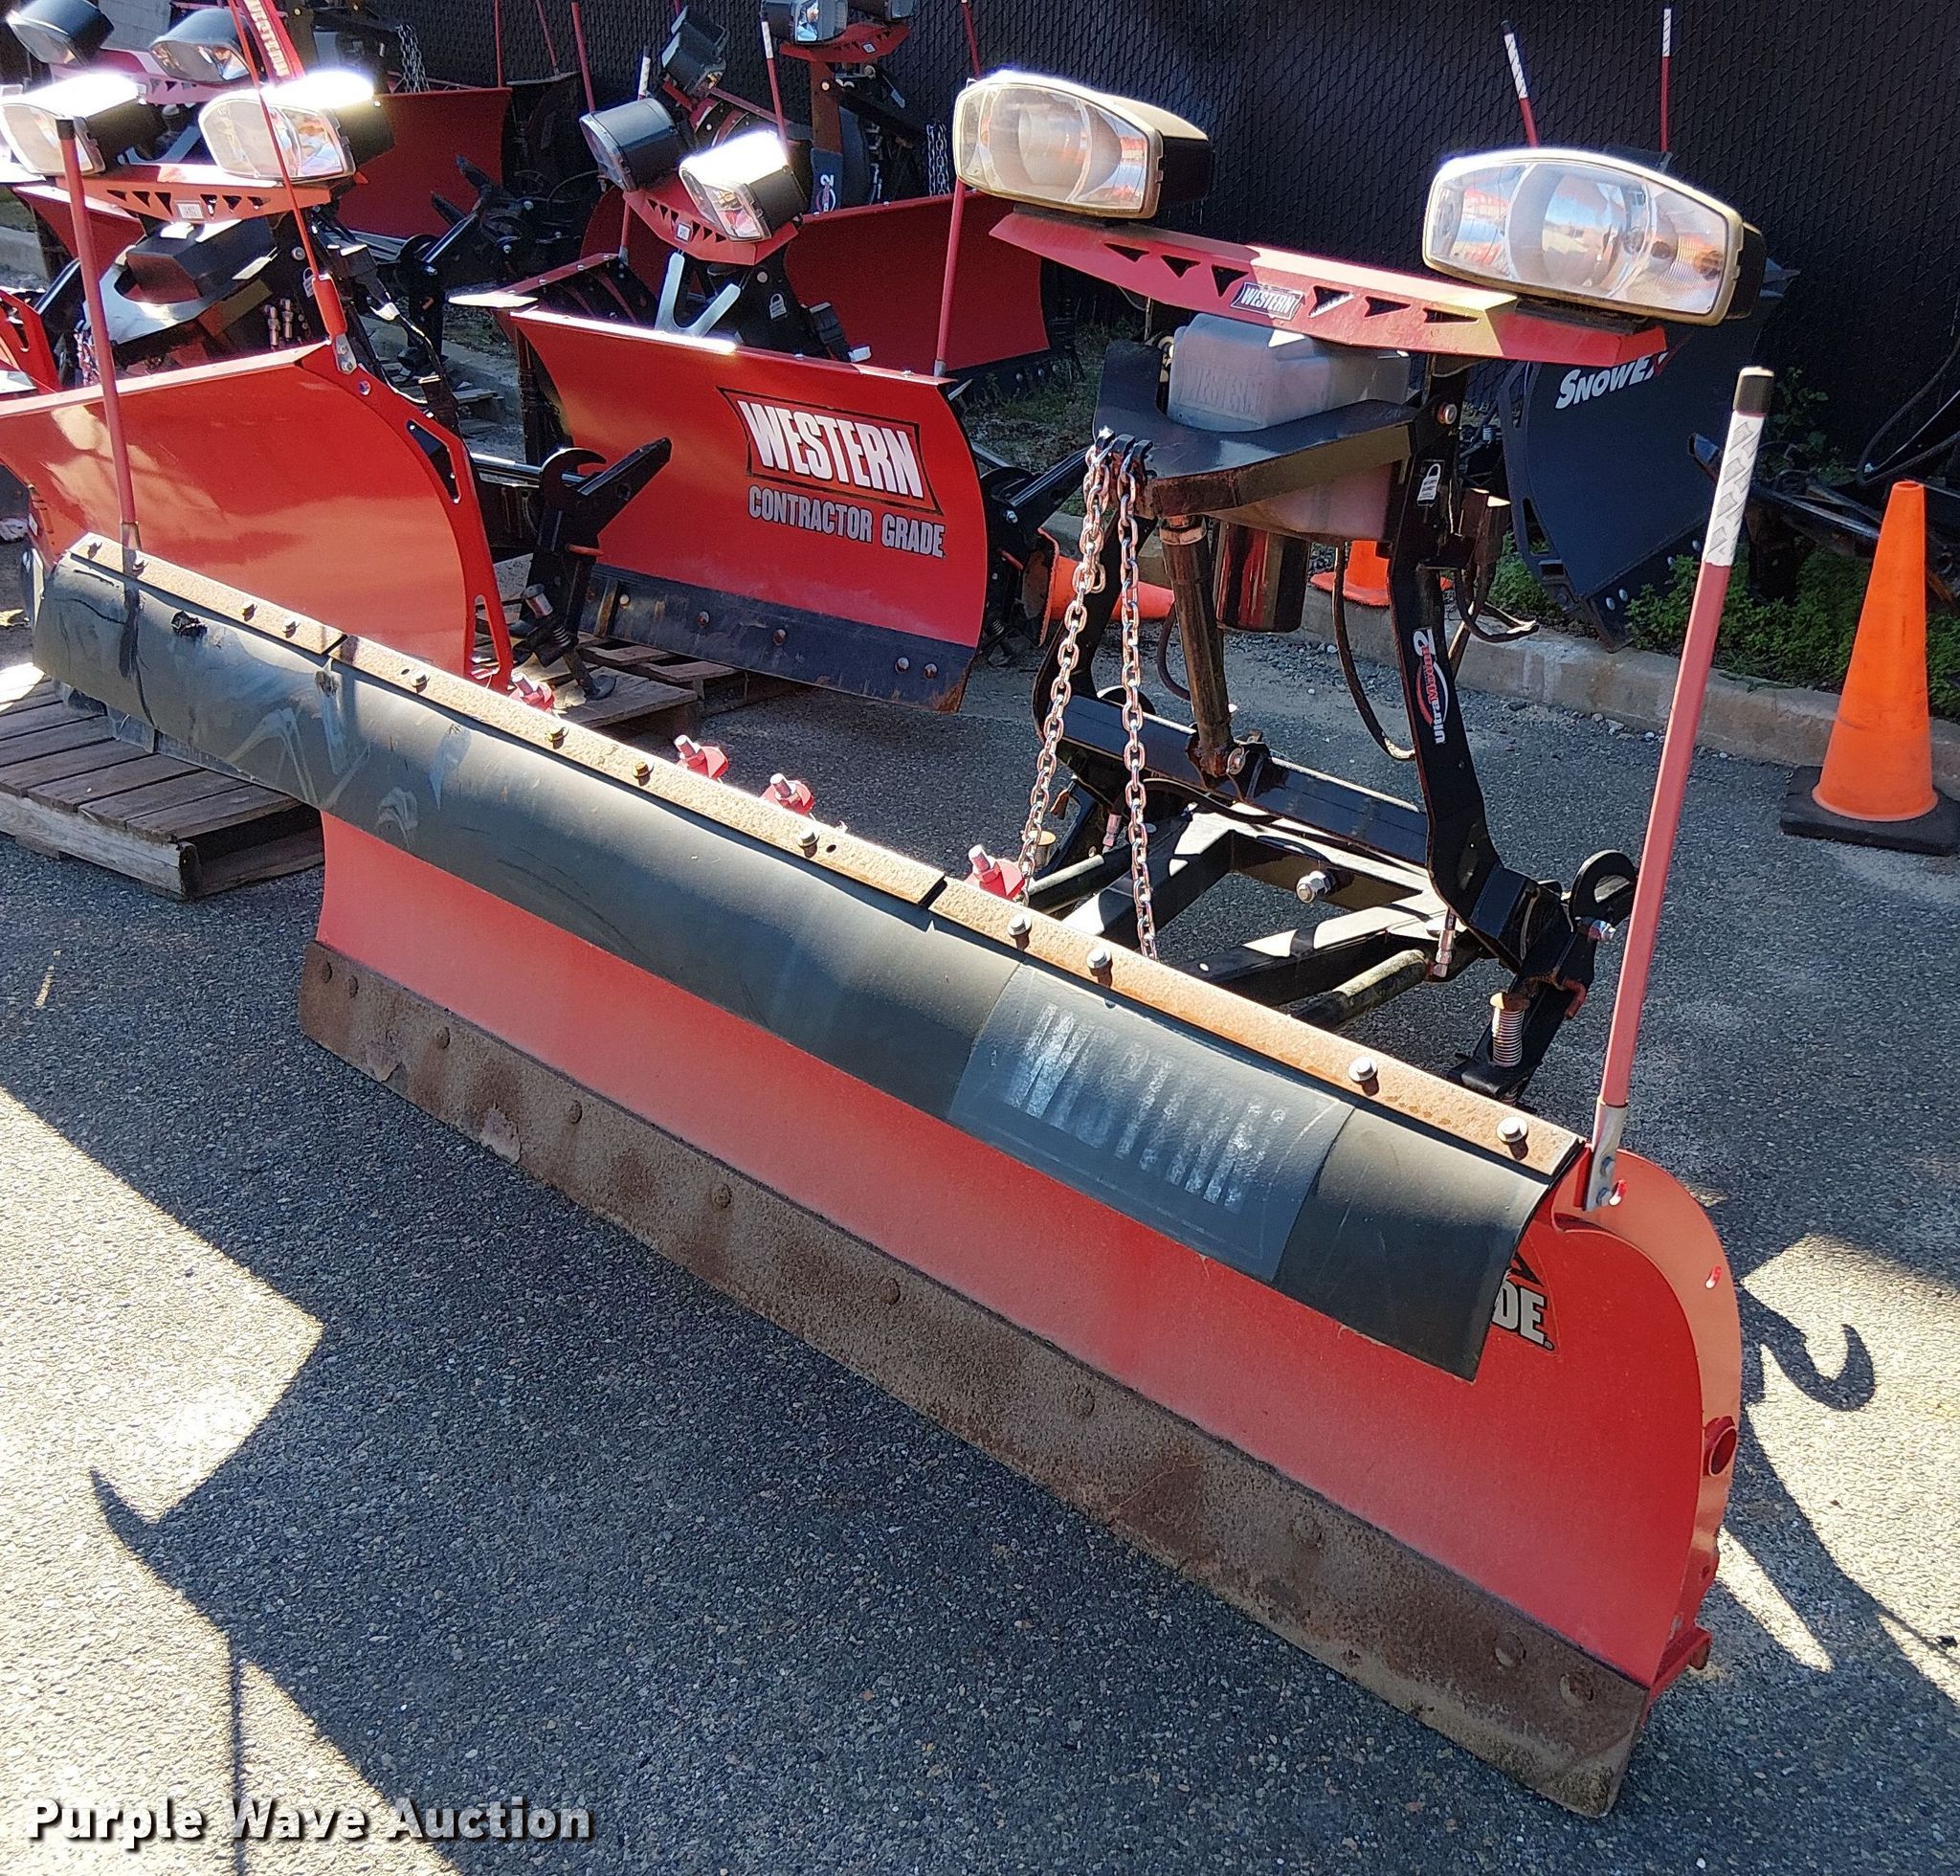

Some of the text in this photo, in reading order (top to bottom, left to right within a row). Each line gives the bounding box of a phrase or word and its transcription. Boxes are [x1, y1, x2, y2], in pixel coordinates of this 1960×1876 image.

[1240, 286, 1297, 314] WESTERN
[737, 400, 924, 499] WESTERN
[748, 485, 946, 558] CONTRACTOR GRADE
